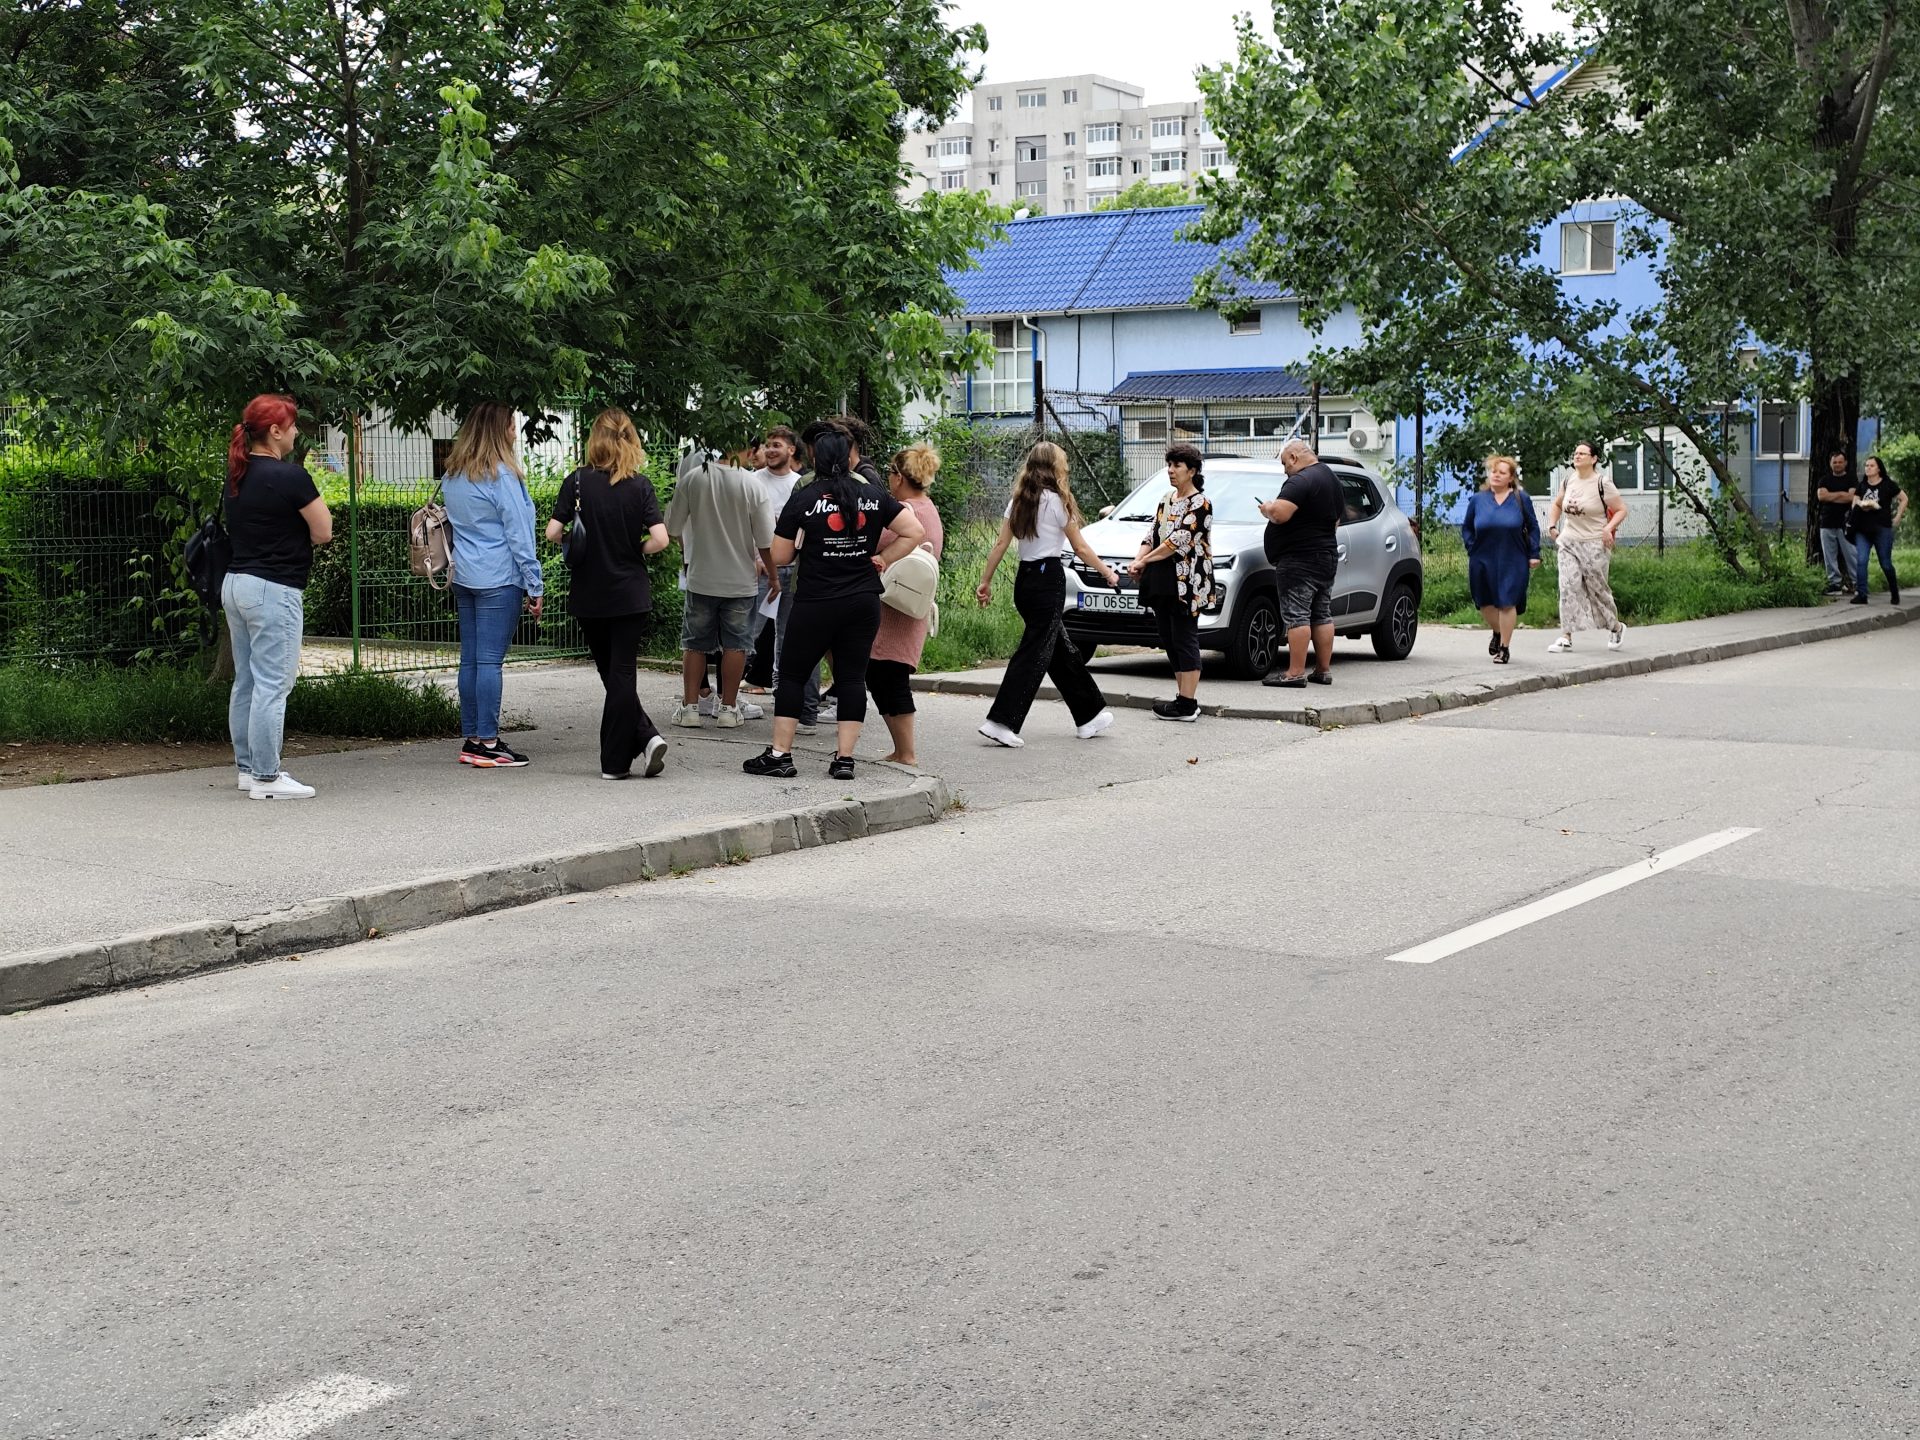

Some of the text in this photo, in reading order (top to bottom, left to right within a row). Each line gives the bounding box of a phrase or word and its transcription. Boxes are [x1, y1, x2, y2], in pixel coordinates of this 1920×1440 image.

[805, 497, 879, 516] Mon héri
[1085, 595, 1099, 607] OT
[1104, 596, 1117, 608] 06
